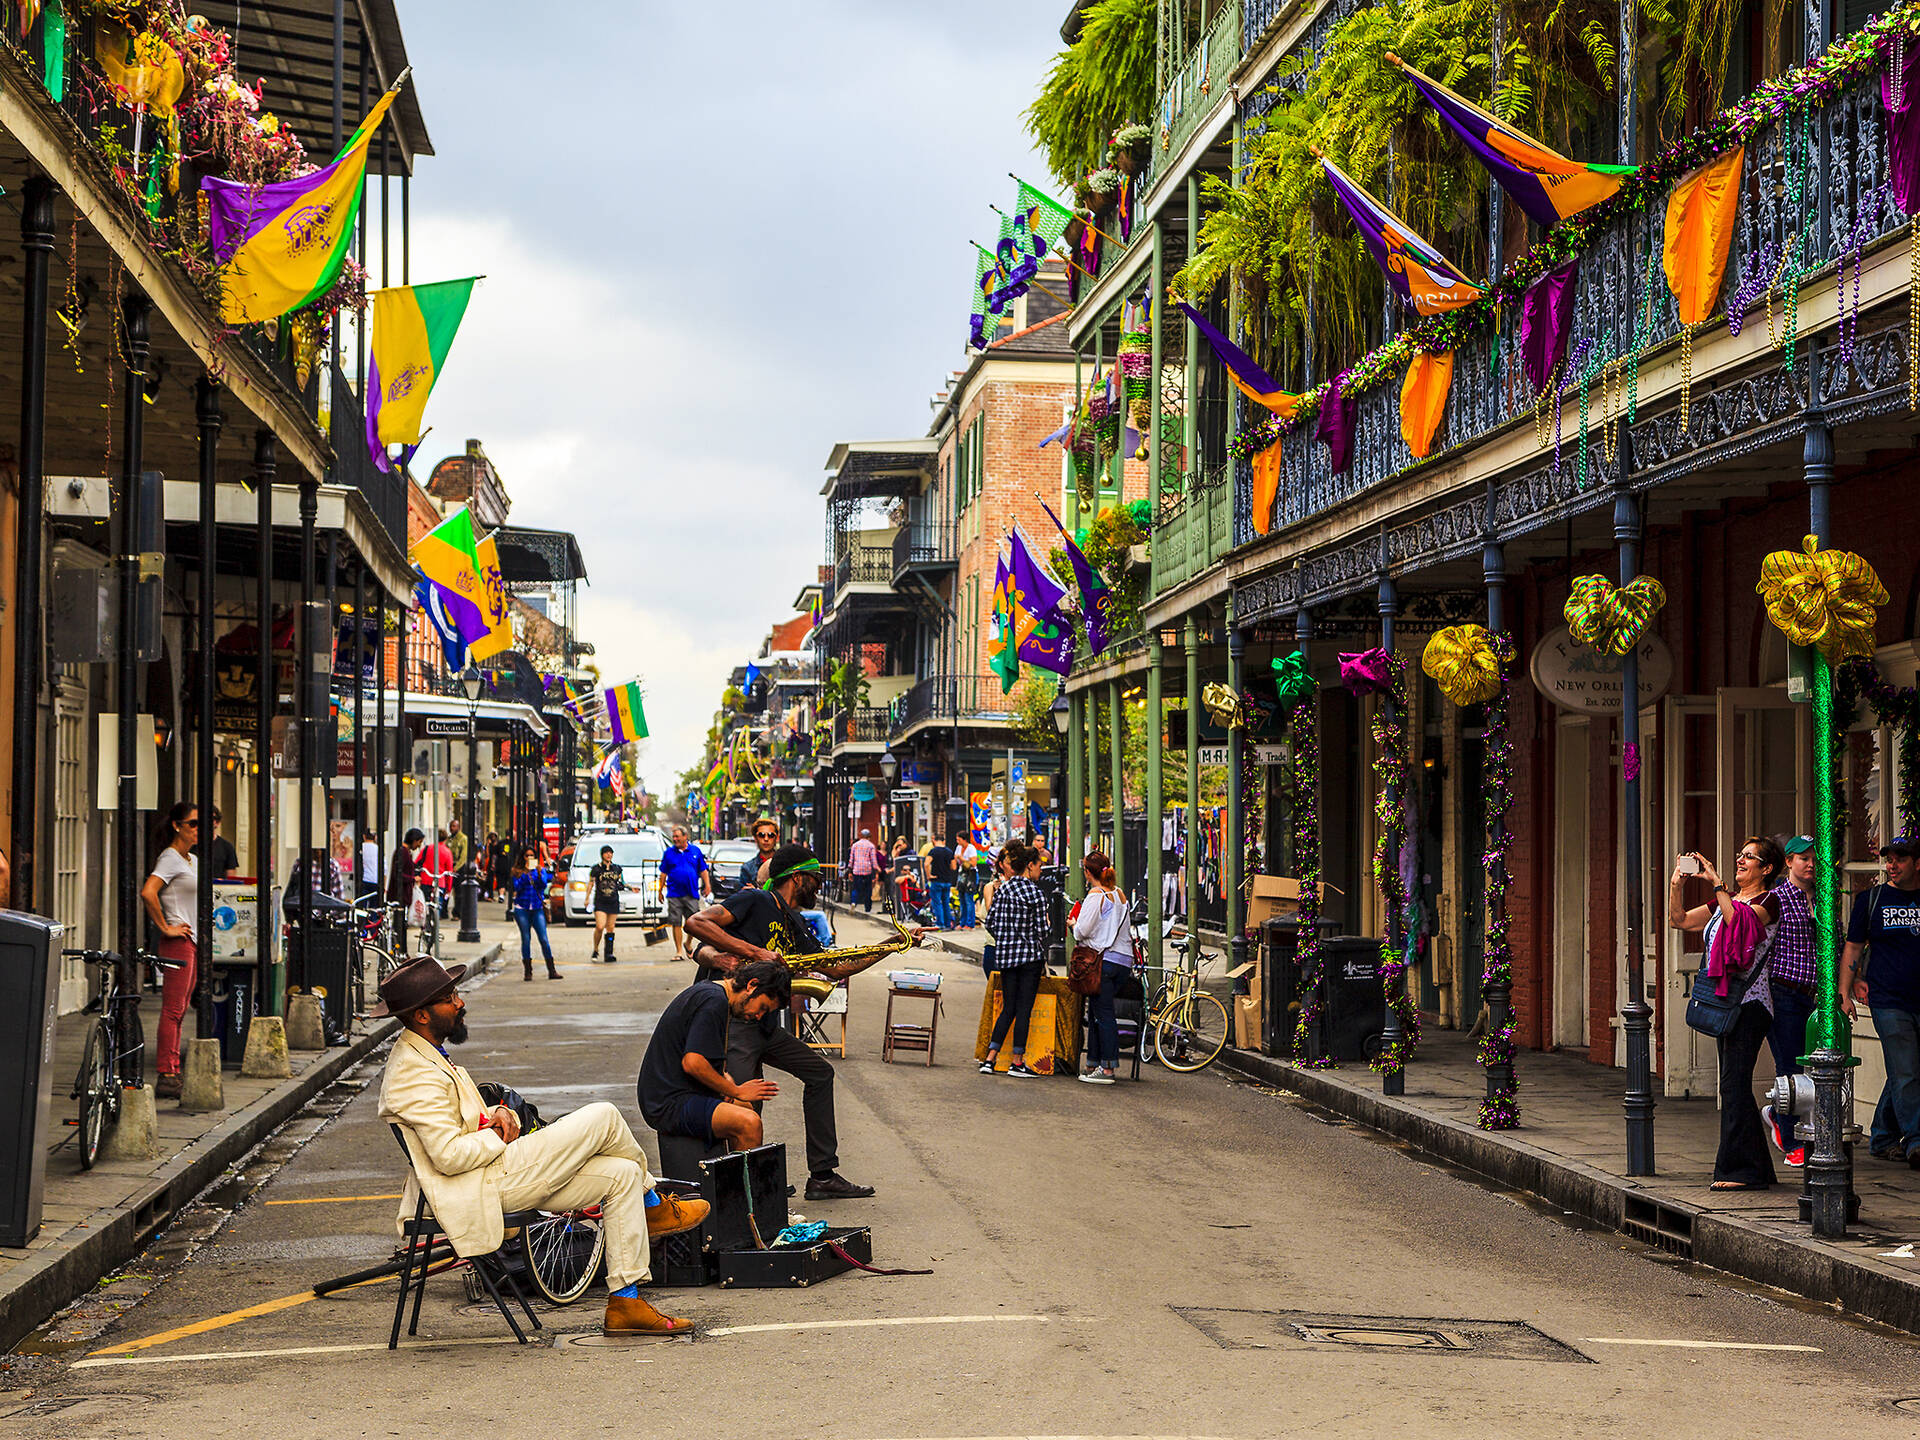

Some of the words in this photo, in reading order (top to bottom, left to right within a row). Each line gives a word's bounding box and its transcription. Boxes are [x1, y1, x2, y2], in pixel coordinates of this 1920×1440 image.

[1401, 290, 1458, 307] MARDI
[1555, 680, 1586, 691] NEW
[430, 723, 465, 731] Orleans
